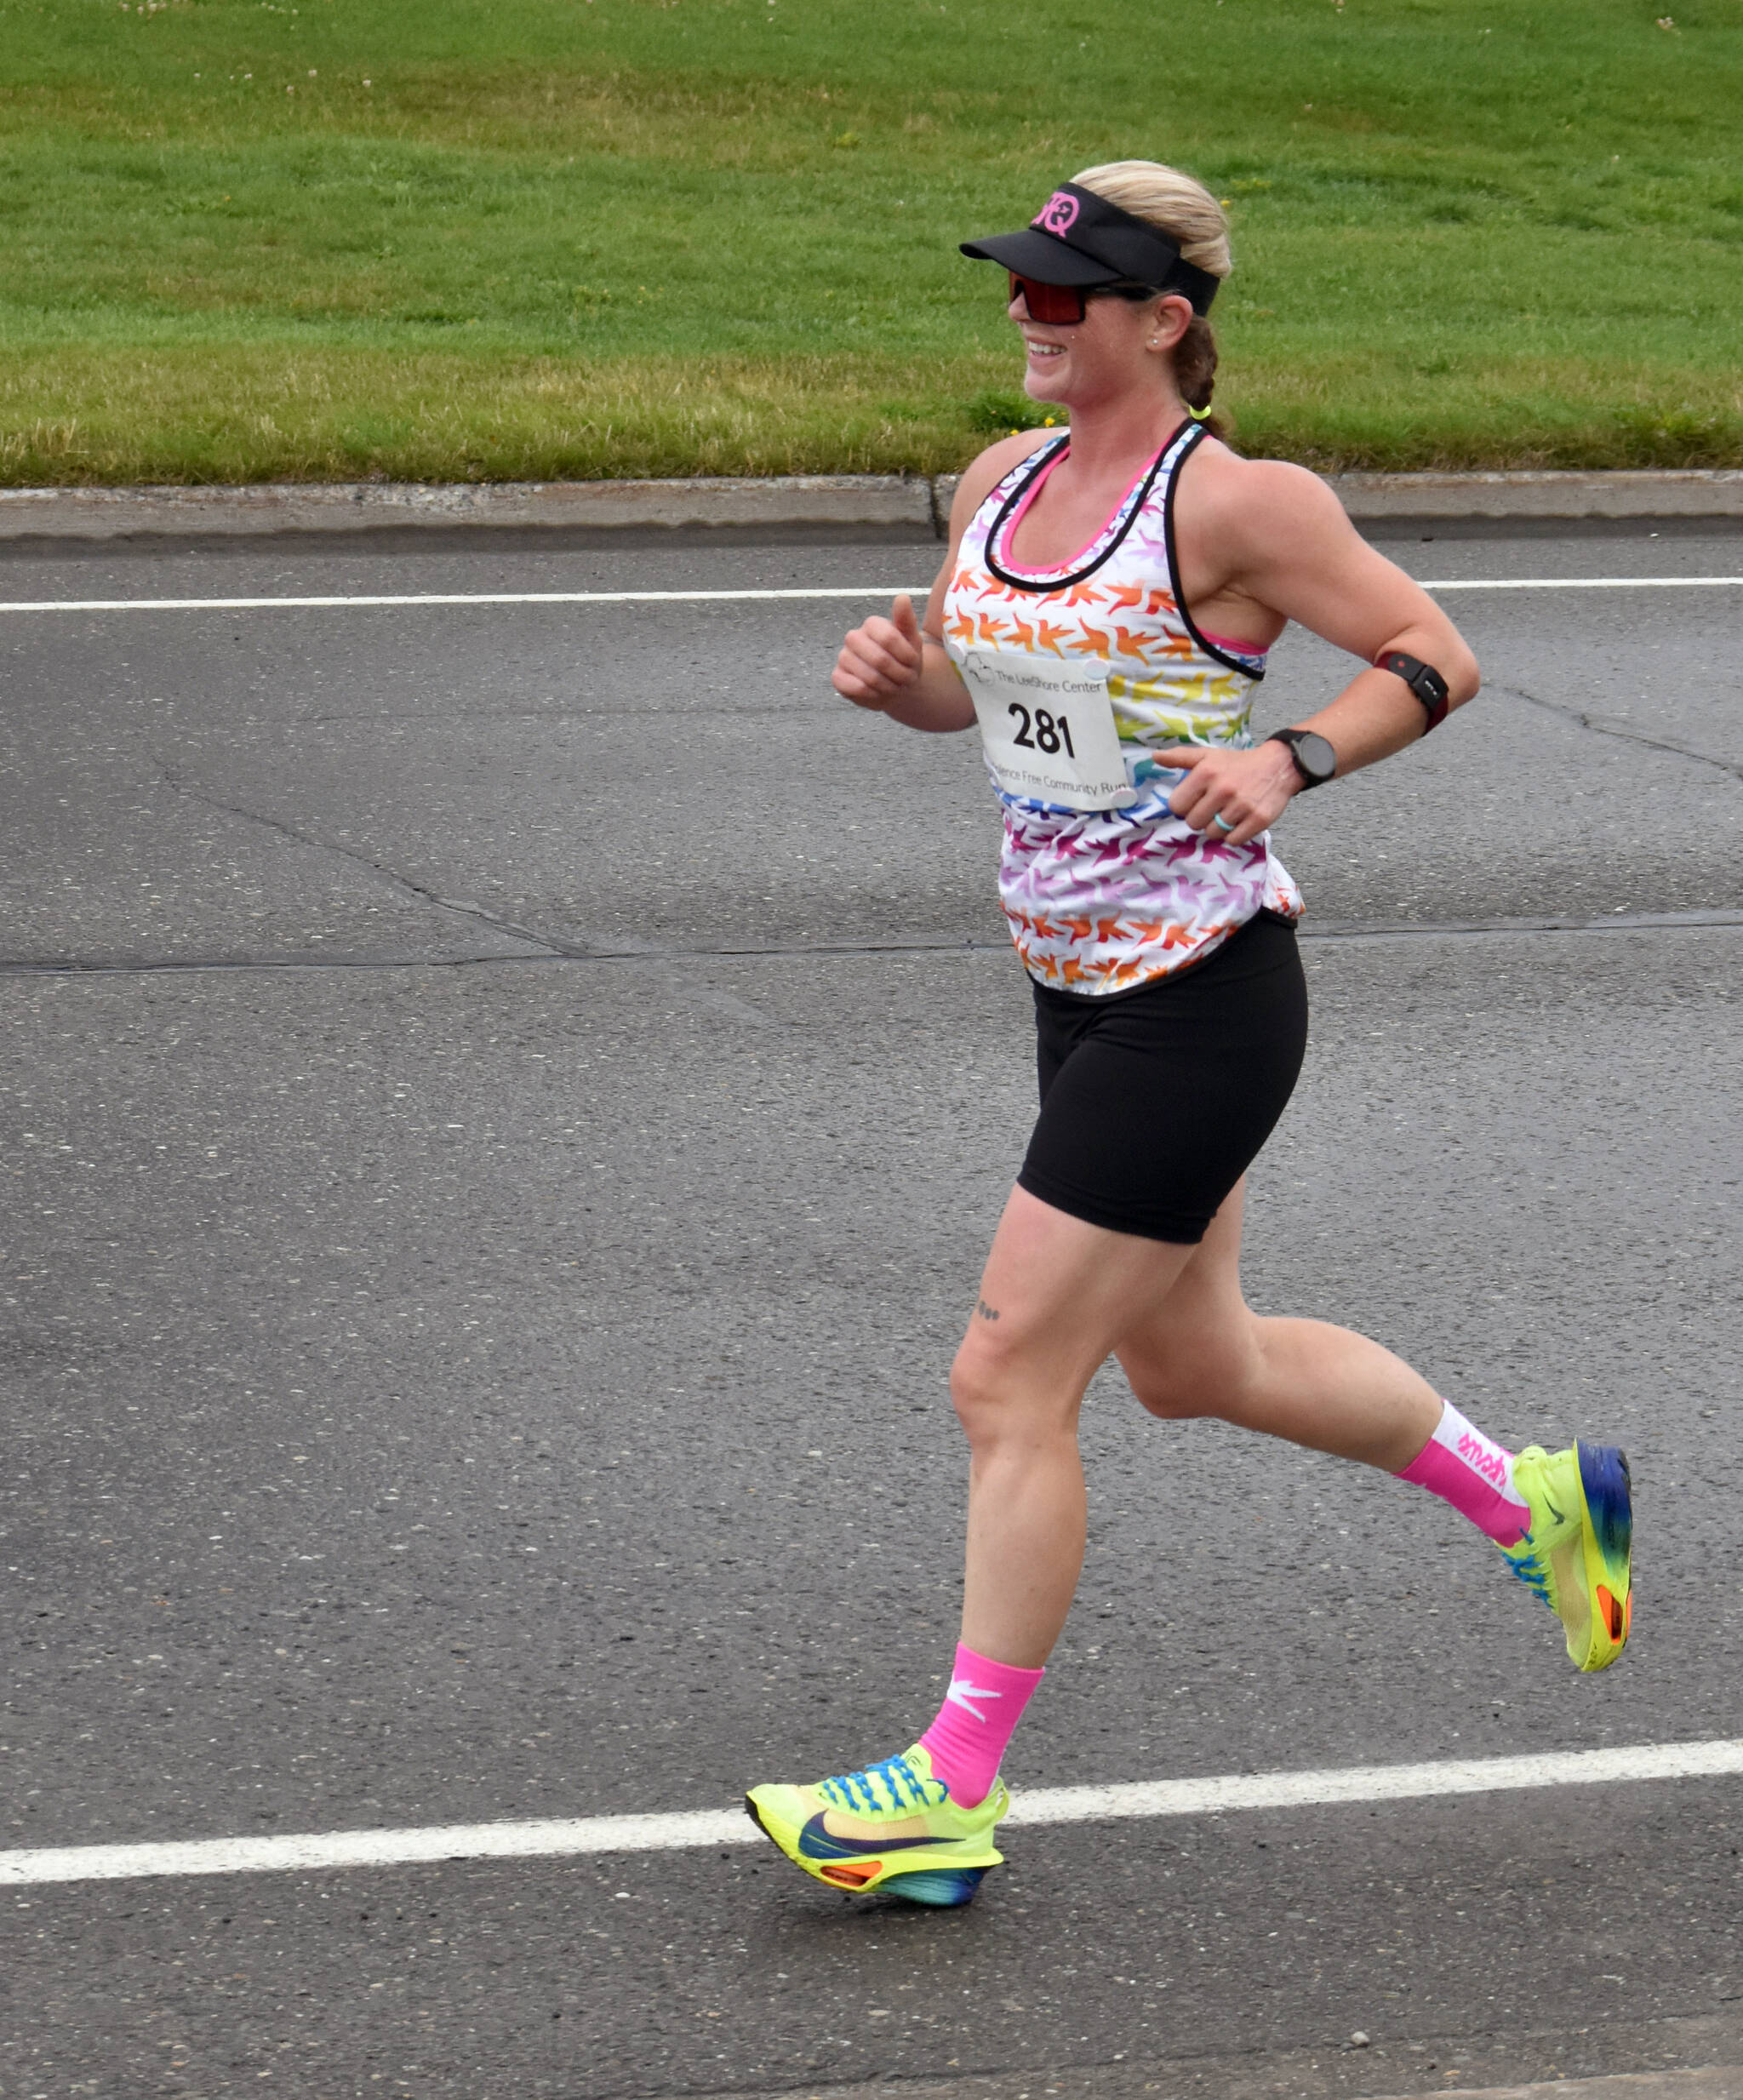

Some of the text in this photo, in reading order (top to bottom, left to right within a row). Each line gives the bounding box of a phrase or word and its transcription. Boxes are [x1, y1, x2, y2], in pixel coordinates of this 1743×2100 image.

[996, 670, 1014, 684] The
[1061, 679, 1101, 694] Center
[1008, 702, 1075, 758] 281
[1021, 770, 1043, 786] Free
[1043, 775, 1097, 796] Community
